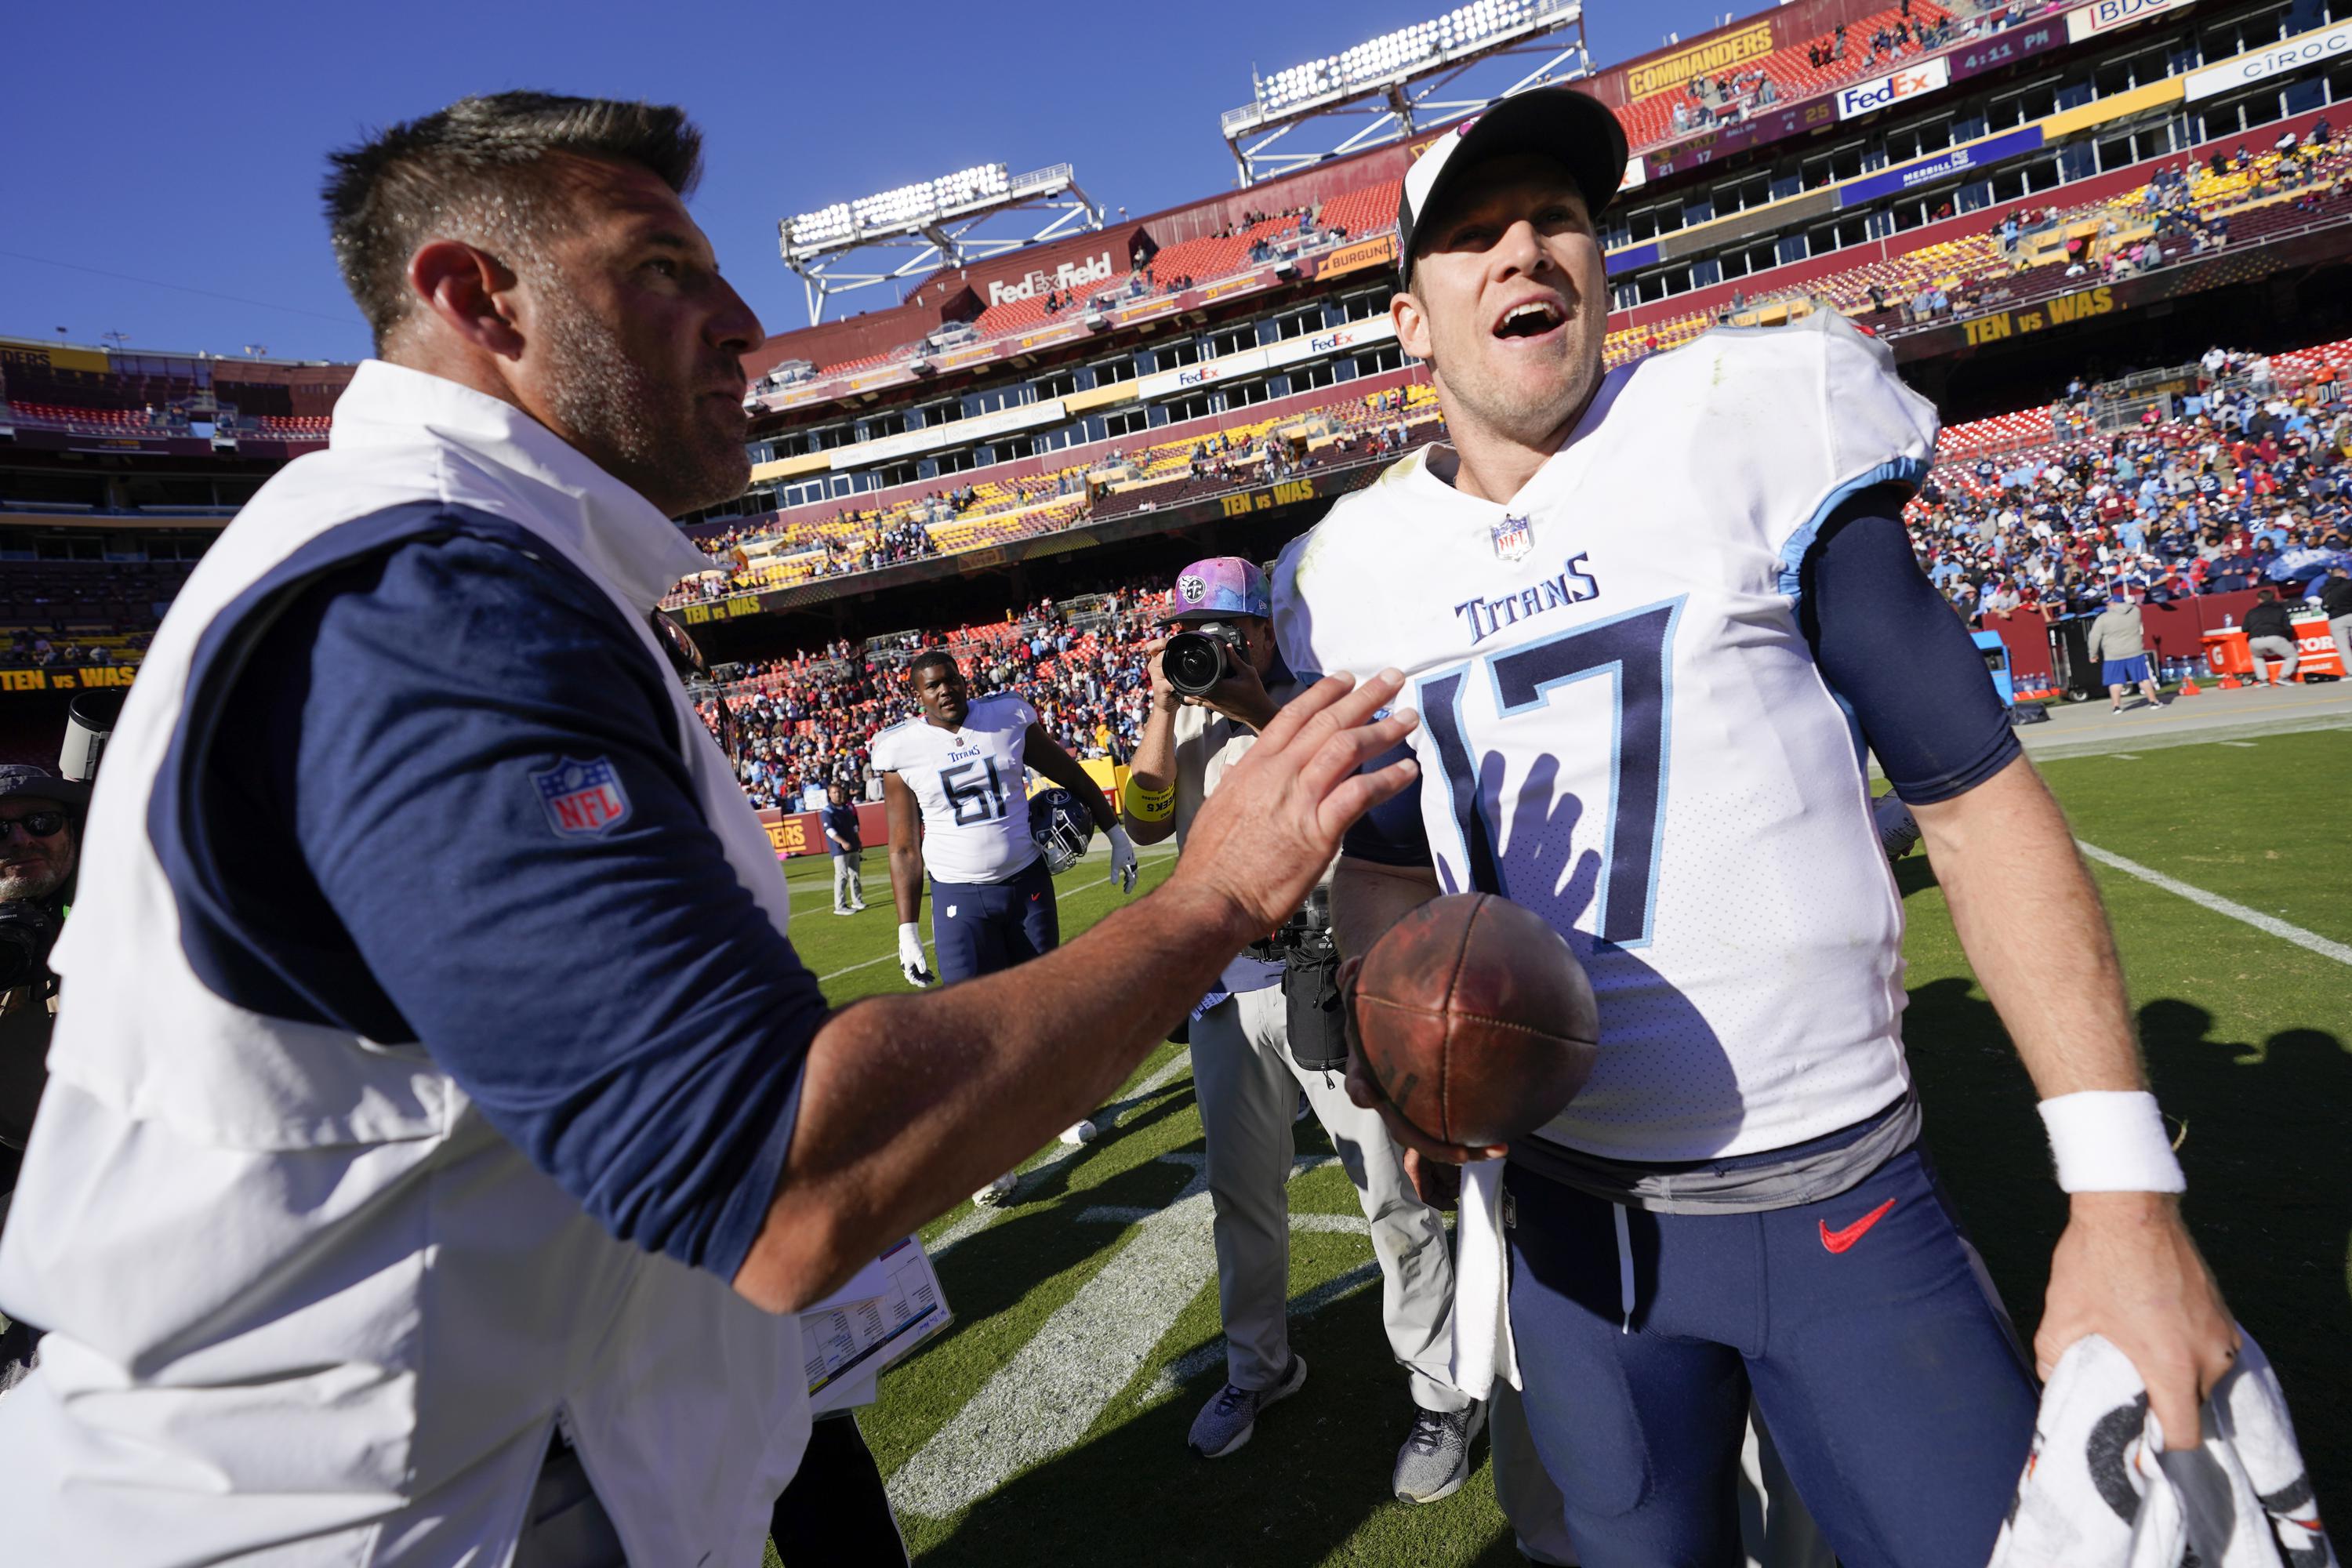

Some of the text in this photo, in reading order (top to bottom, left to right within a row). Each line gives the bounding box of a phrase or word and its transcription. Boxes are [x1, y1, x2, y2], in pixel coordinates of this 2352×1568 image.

[2100, 0, 2165, 22] BD
[1965, 29, 2049, 69] 4:11 PM
[2244, 34, 2347, 78] CÎROC
[1629, 27, 1773, 96] COMMANDERS
[1845, 72, 1929, 114] FedEx
[1805, 103, 1830, 123] 25
[1785, 122, 1795, 132] 4
[1696, 150, 1712, 164] 17
[1658, 162, 1675, 178] 21
[1903, 161, 1952, 183] MERRILL
[1962, 311, 2013, 347] TEN
[2047, 285, 2114, 325] WAS
[1311, 332, 1354, 353] FedEx
[1179, 366, 1219, 386] FedEx
[1220, 492, 1253, 517] TEN
[1272, 478, 1315, 506] WAS
[1498, 530, 1528, 553] NFL
[1454, 550, 1600, 646] TITANS
[683, 604, 710, 625] TEN
[726, 595, 760, 618] WAS
[2212, 646, 2224, 666] G
[0, 670, 47, 691] TEN
[78, 666, 136, 688] WAS
[948, 744, 981, 763] TITANS
[1414, 593, 1689, 950] 17
[938, 753, 1006, 829] 51
[554, 786, 623, 829] NFL
[1146, 803, 1155, 812] 5
[1156, 795, 1174, 812] EEK
